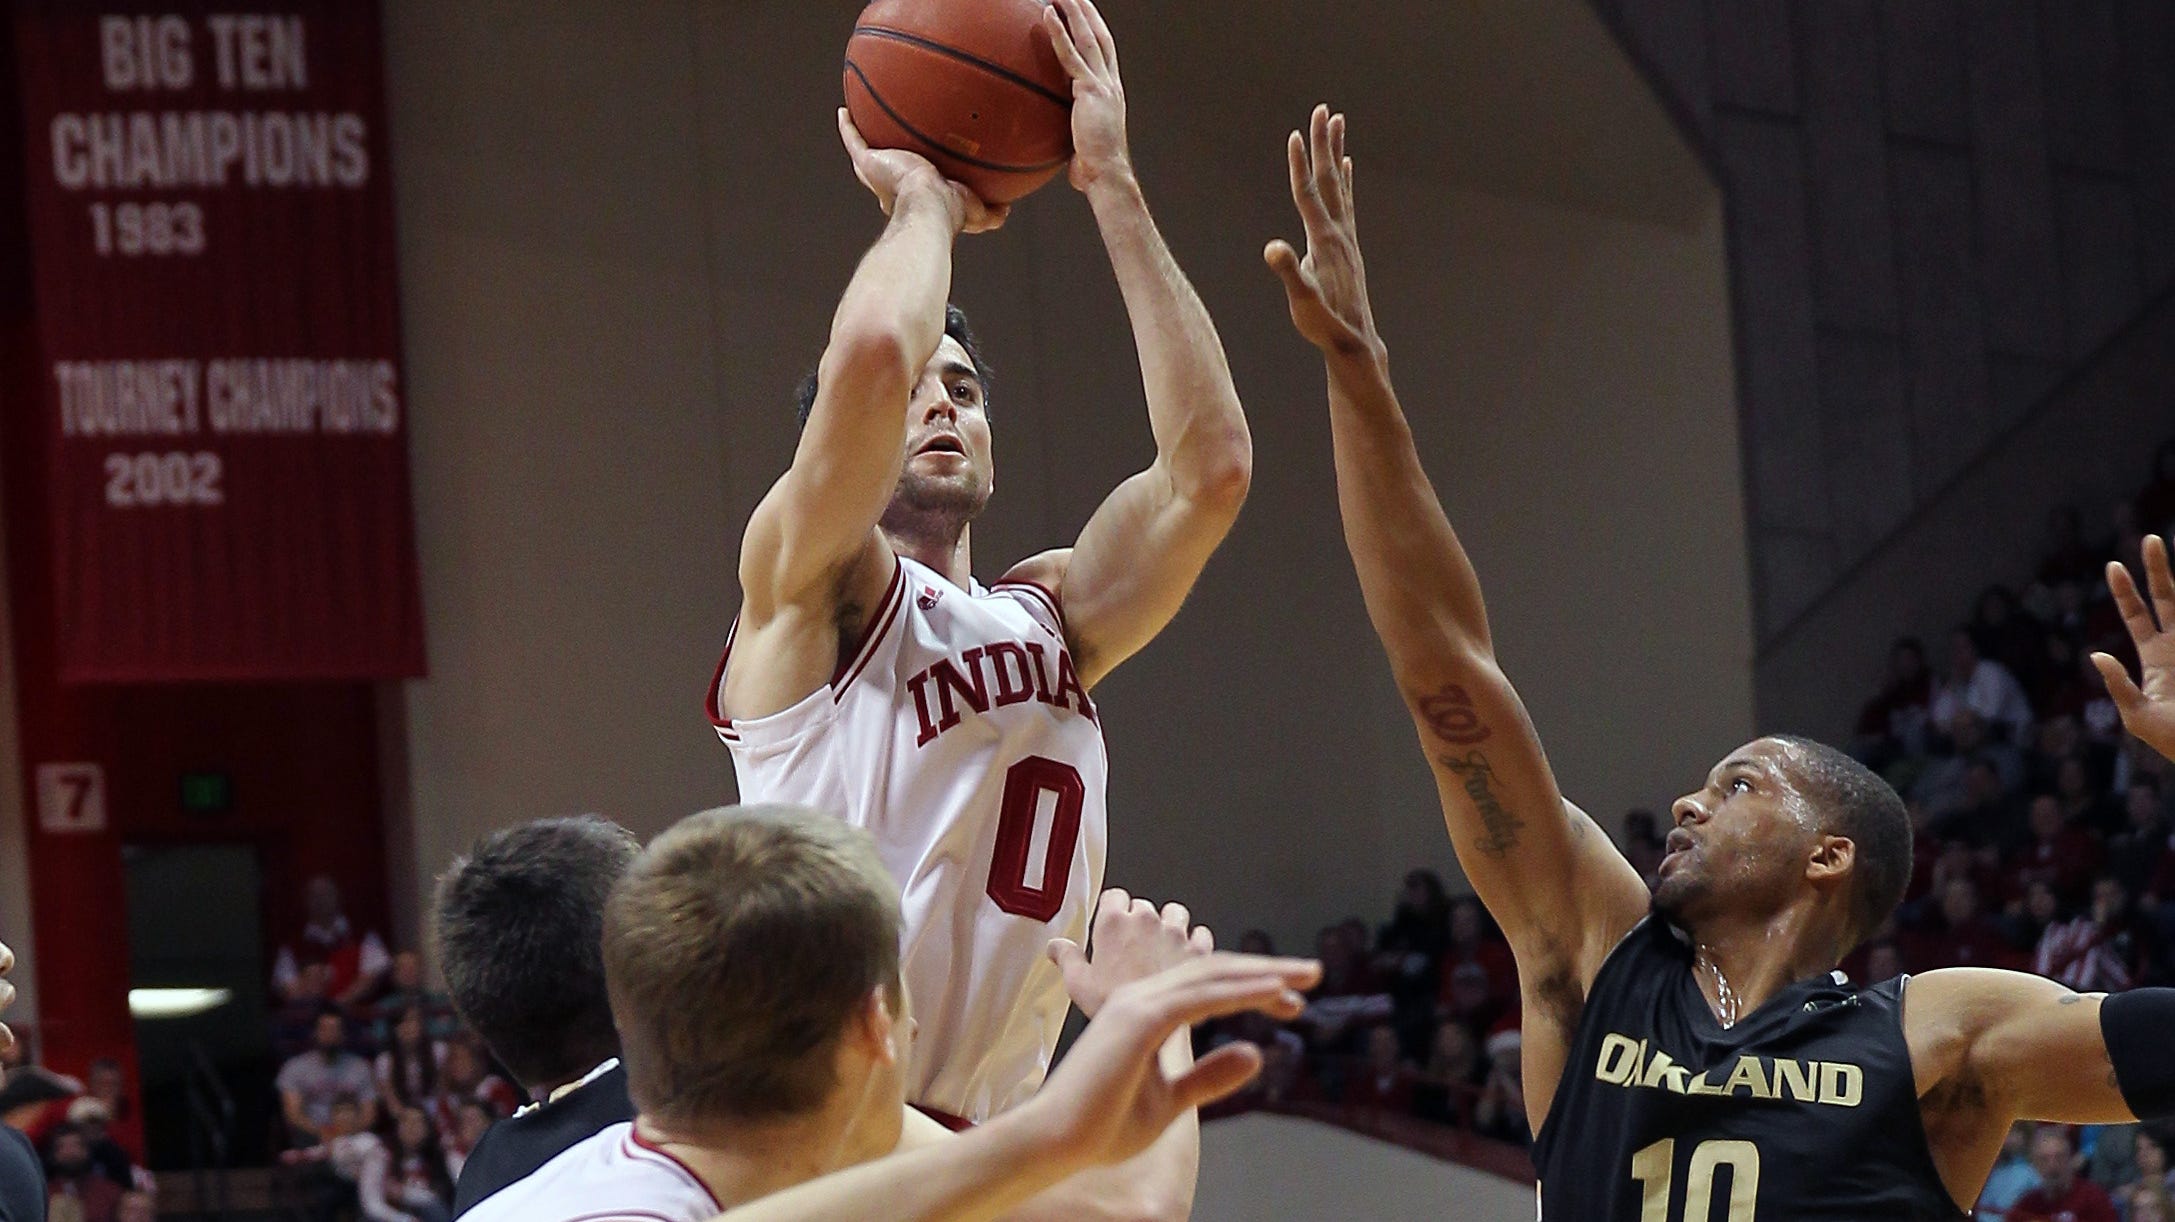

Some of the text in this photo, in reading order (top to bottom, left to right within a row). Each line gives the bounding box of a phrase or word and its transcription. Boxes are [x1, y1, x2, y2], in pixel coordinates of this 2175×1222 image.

[103, 14, 306, 90] BIG TEN
[51, 111, 369, 189] CHAMPIONS
[90, 201, 205, 256] 1983
[56, 357, 398, 437] TOURNEY CHAMPIONS
[105, 452, 225, 507] 2002
[58, 774, 93, 819] 7
[986, 755, 1085, 922] 0
[1631, 1137, 1760, 1222] 10
